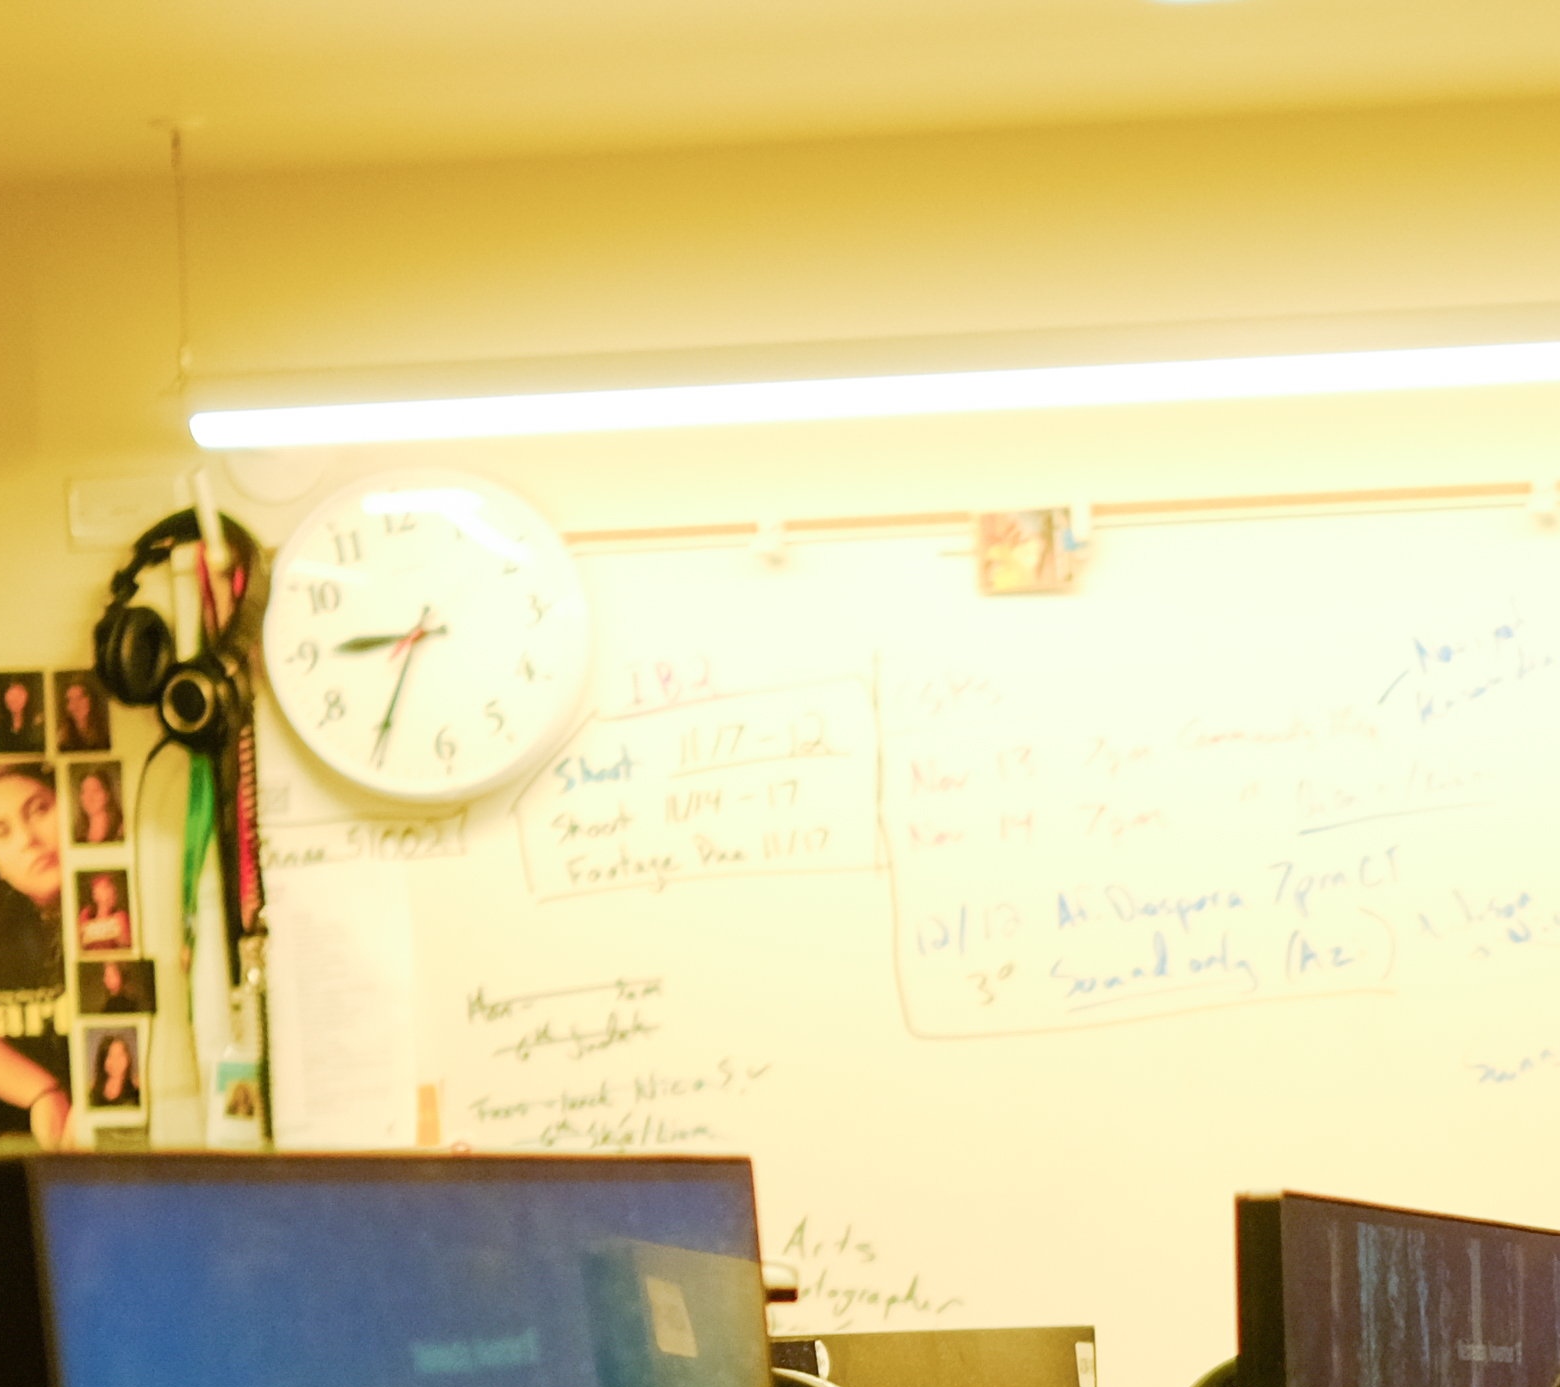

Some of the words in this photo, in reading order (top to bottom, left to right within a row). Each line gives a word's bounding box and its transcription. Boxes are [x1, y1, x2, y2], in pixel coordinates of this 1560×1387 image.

[332, 529, 364, 565] 11
[309, 582, 343, 613] 10
[483, 698, 506, 737] 5
[434, 724, 458, 762] 6
[799, 1266, 964, 1321] otographer
